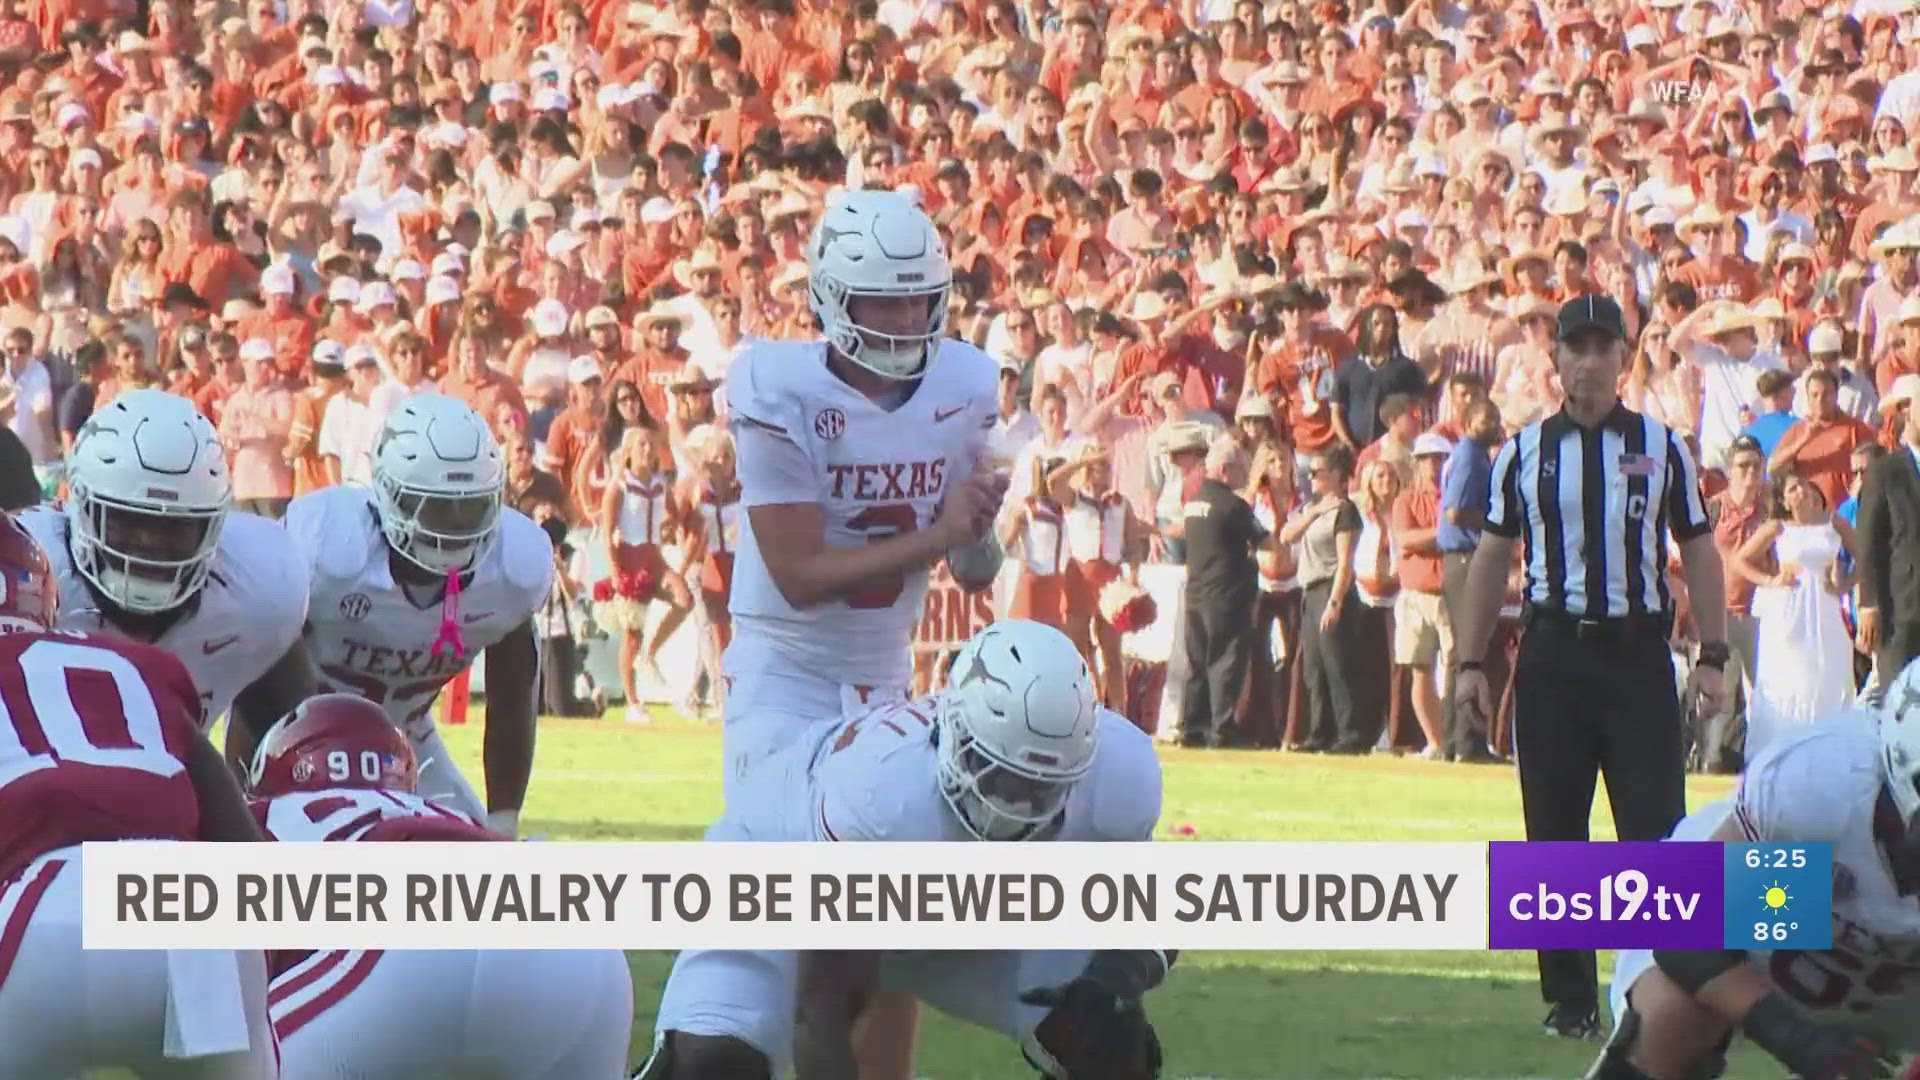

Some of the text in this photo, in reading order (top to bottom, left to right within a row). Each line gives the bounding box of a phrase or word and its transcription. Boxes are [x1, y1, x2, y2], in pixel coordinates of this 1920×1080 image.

[816, 409, 845, 439] SEC
[827, 458, 946, 500] TEXAS
[1628, 495, 1646, 519] C
[911, 588, 994, 641] RNS
[327, 751, 380, 781] 90
